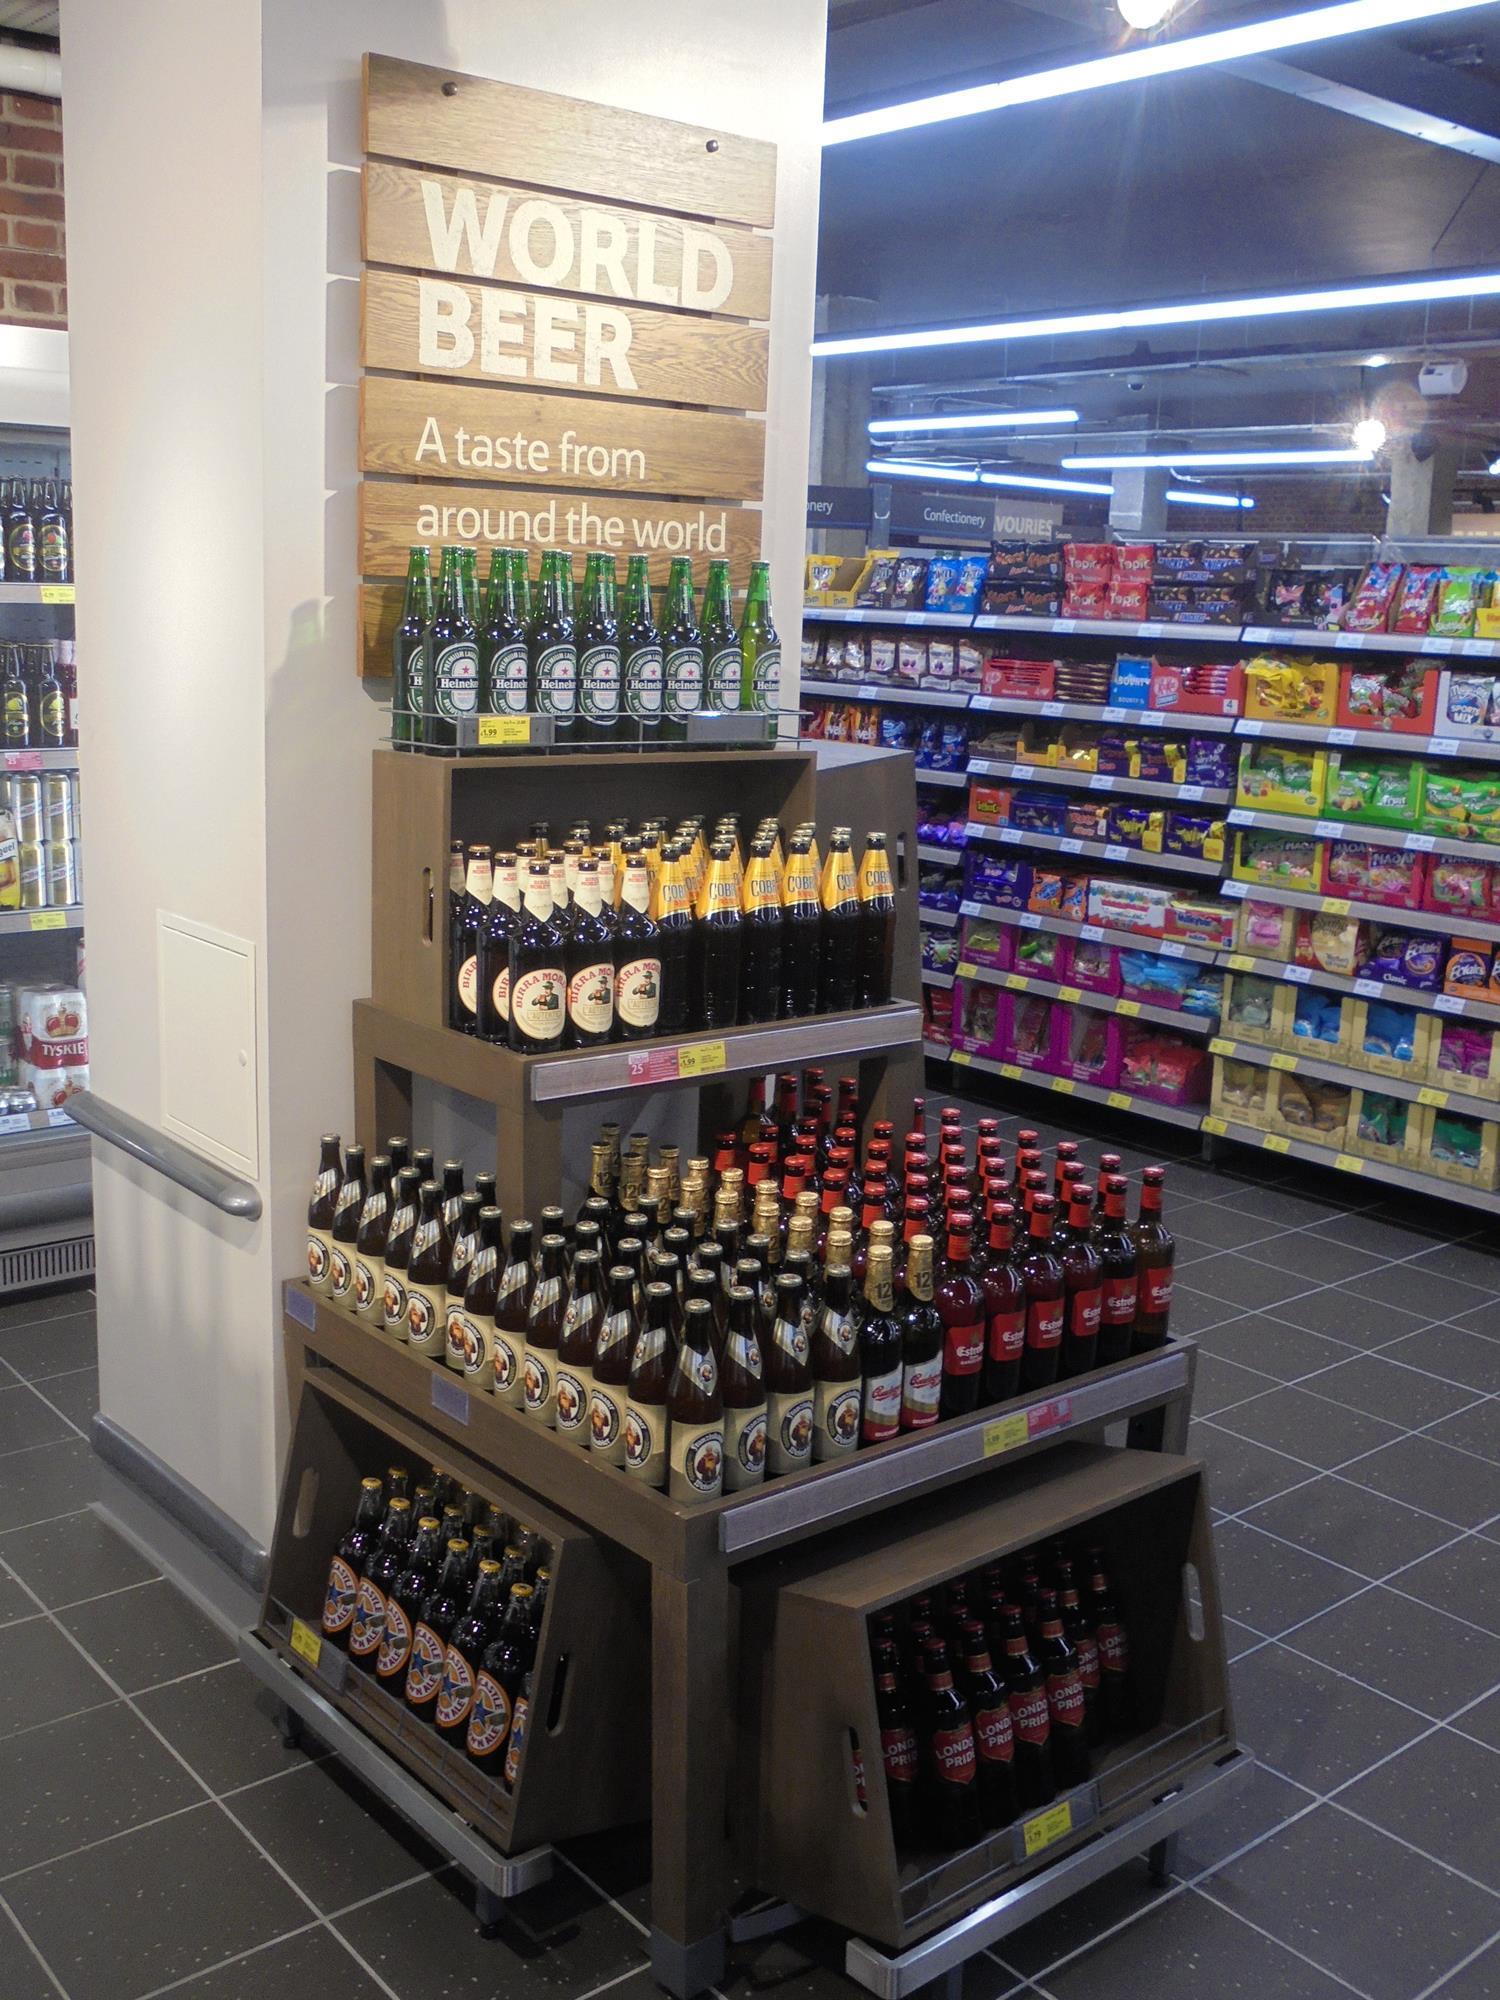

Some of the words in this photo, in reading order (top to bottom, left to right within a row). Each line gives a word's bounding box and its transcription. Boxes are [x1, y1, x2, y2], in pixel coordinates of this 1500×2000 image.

[420, 180, 734, 310] WORLD
[418, 279, 639, 389] BEER
[415, 417, 447, 463] A
[454, 427, 549, 472] taste
[559, 431, 646, 480] from
[416, 500, 556, 543] around
[565, 503, 624, 546] the
[632, 512, 727, 553] world
[923, 507, 986, 526] Confectionery
[993, 515, 1053, 537] VOURIES
[1227, 700, 1233, 708] 4
[516, 975, 540, 1008] BIRRA
[571, 971, 596, 1004] BIRRA
[616, 965, 640, 998] BIRRA
[42, 1043, 85, 1057] TYSKIE
[632, 1063, 643, 1075] 25
[337, 1607, 350, 1621] ALE
[367, 1629, 379, 1645] ALE
[389, 1650, 400, 1666] ALE
[423, 1676, 437, 1692] ALE
[451, 1701, 464, 1716] ALE
[1012, 1698, 1048, 1721] LONDO
[484, 1727, 499, 1744] ALE
[979, 1717, 1012, 1740] LOND
[936, 1735, 975, 1759] LONDO
[989, 1731, 1014, 1748] PRID
